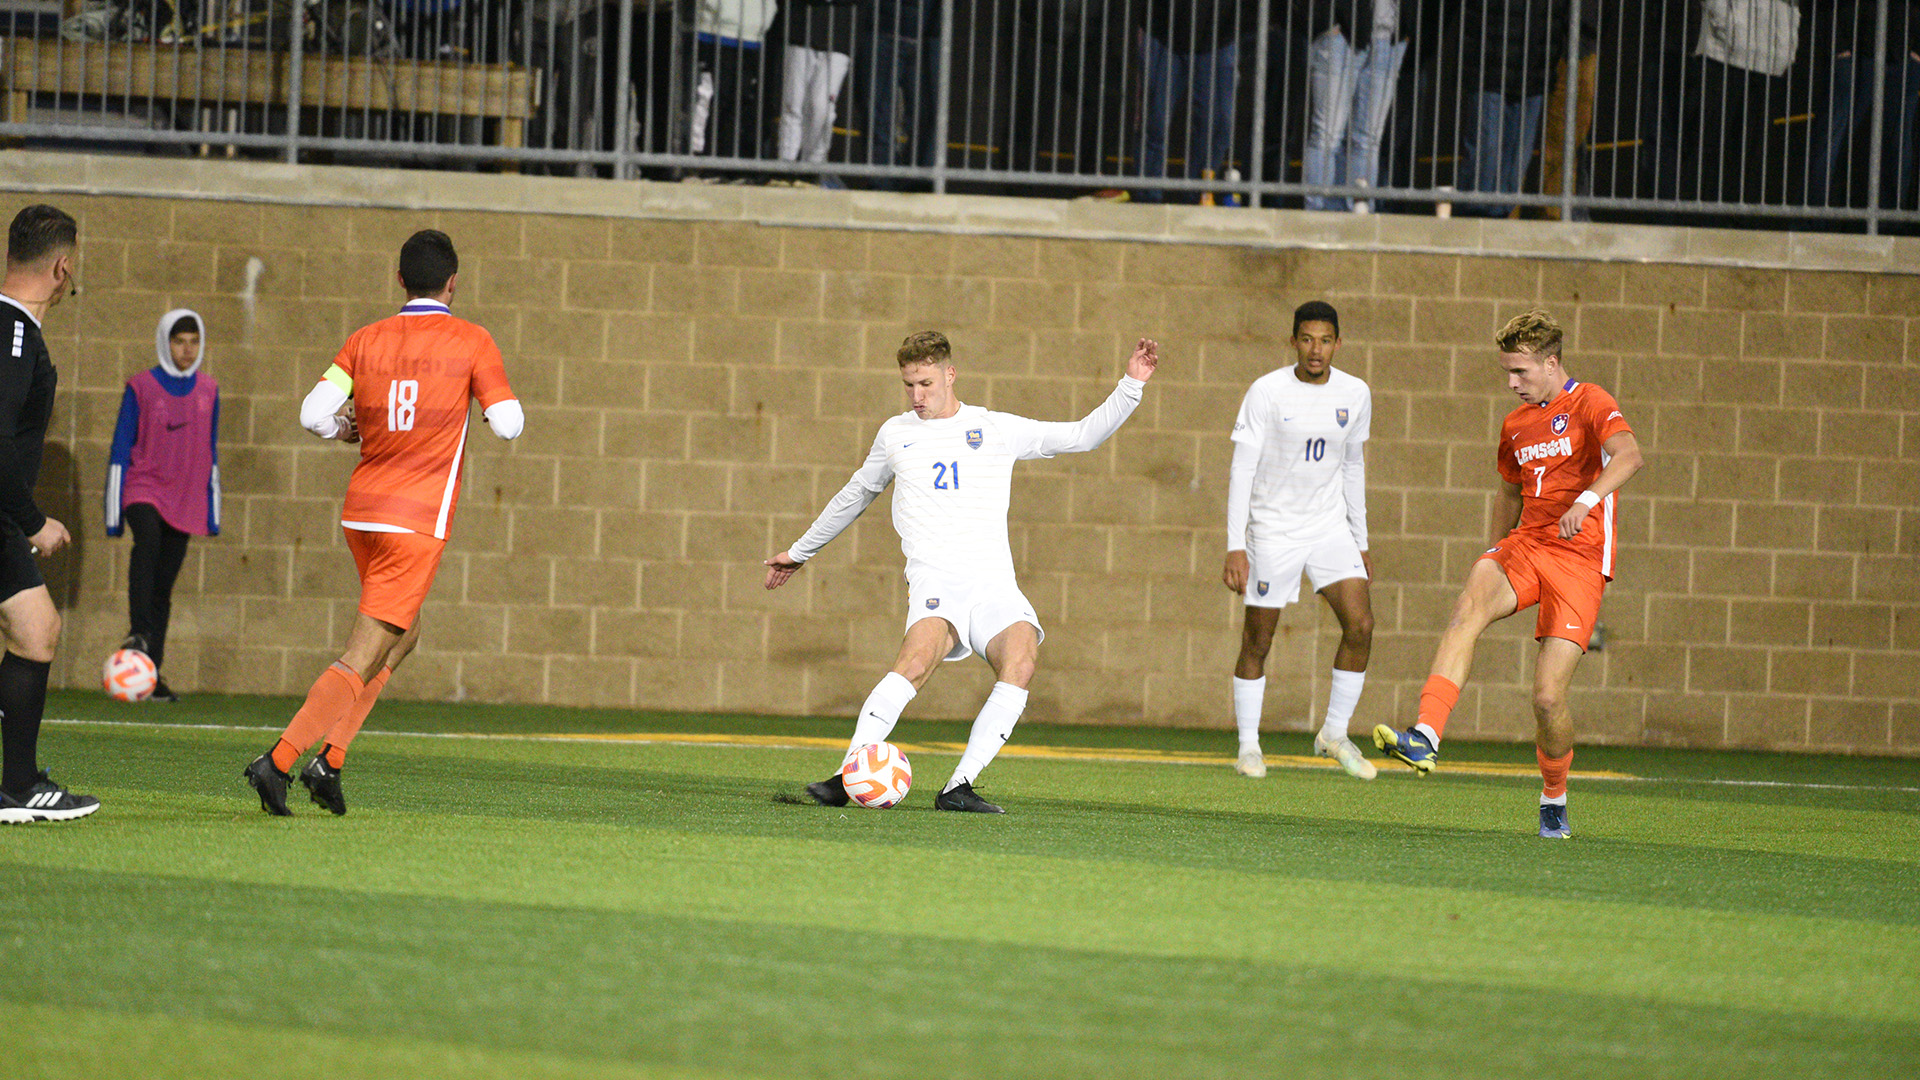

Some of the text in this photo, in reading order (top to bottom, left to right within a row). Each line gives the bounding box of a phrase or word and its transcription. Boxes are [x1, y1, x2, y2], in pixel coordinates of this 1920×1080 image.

[388, 380, 418, 432] 18
[1305, 437, 1326, 462] 10
[1514, 436, 1572, 466] LEMSON
[932, 461, 959, 490] 21
[1534, 466, 1546, 497] 7
